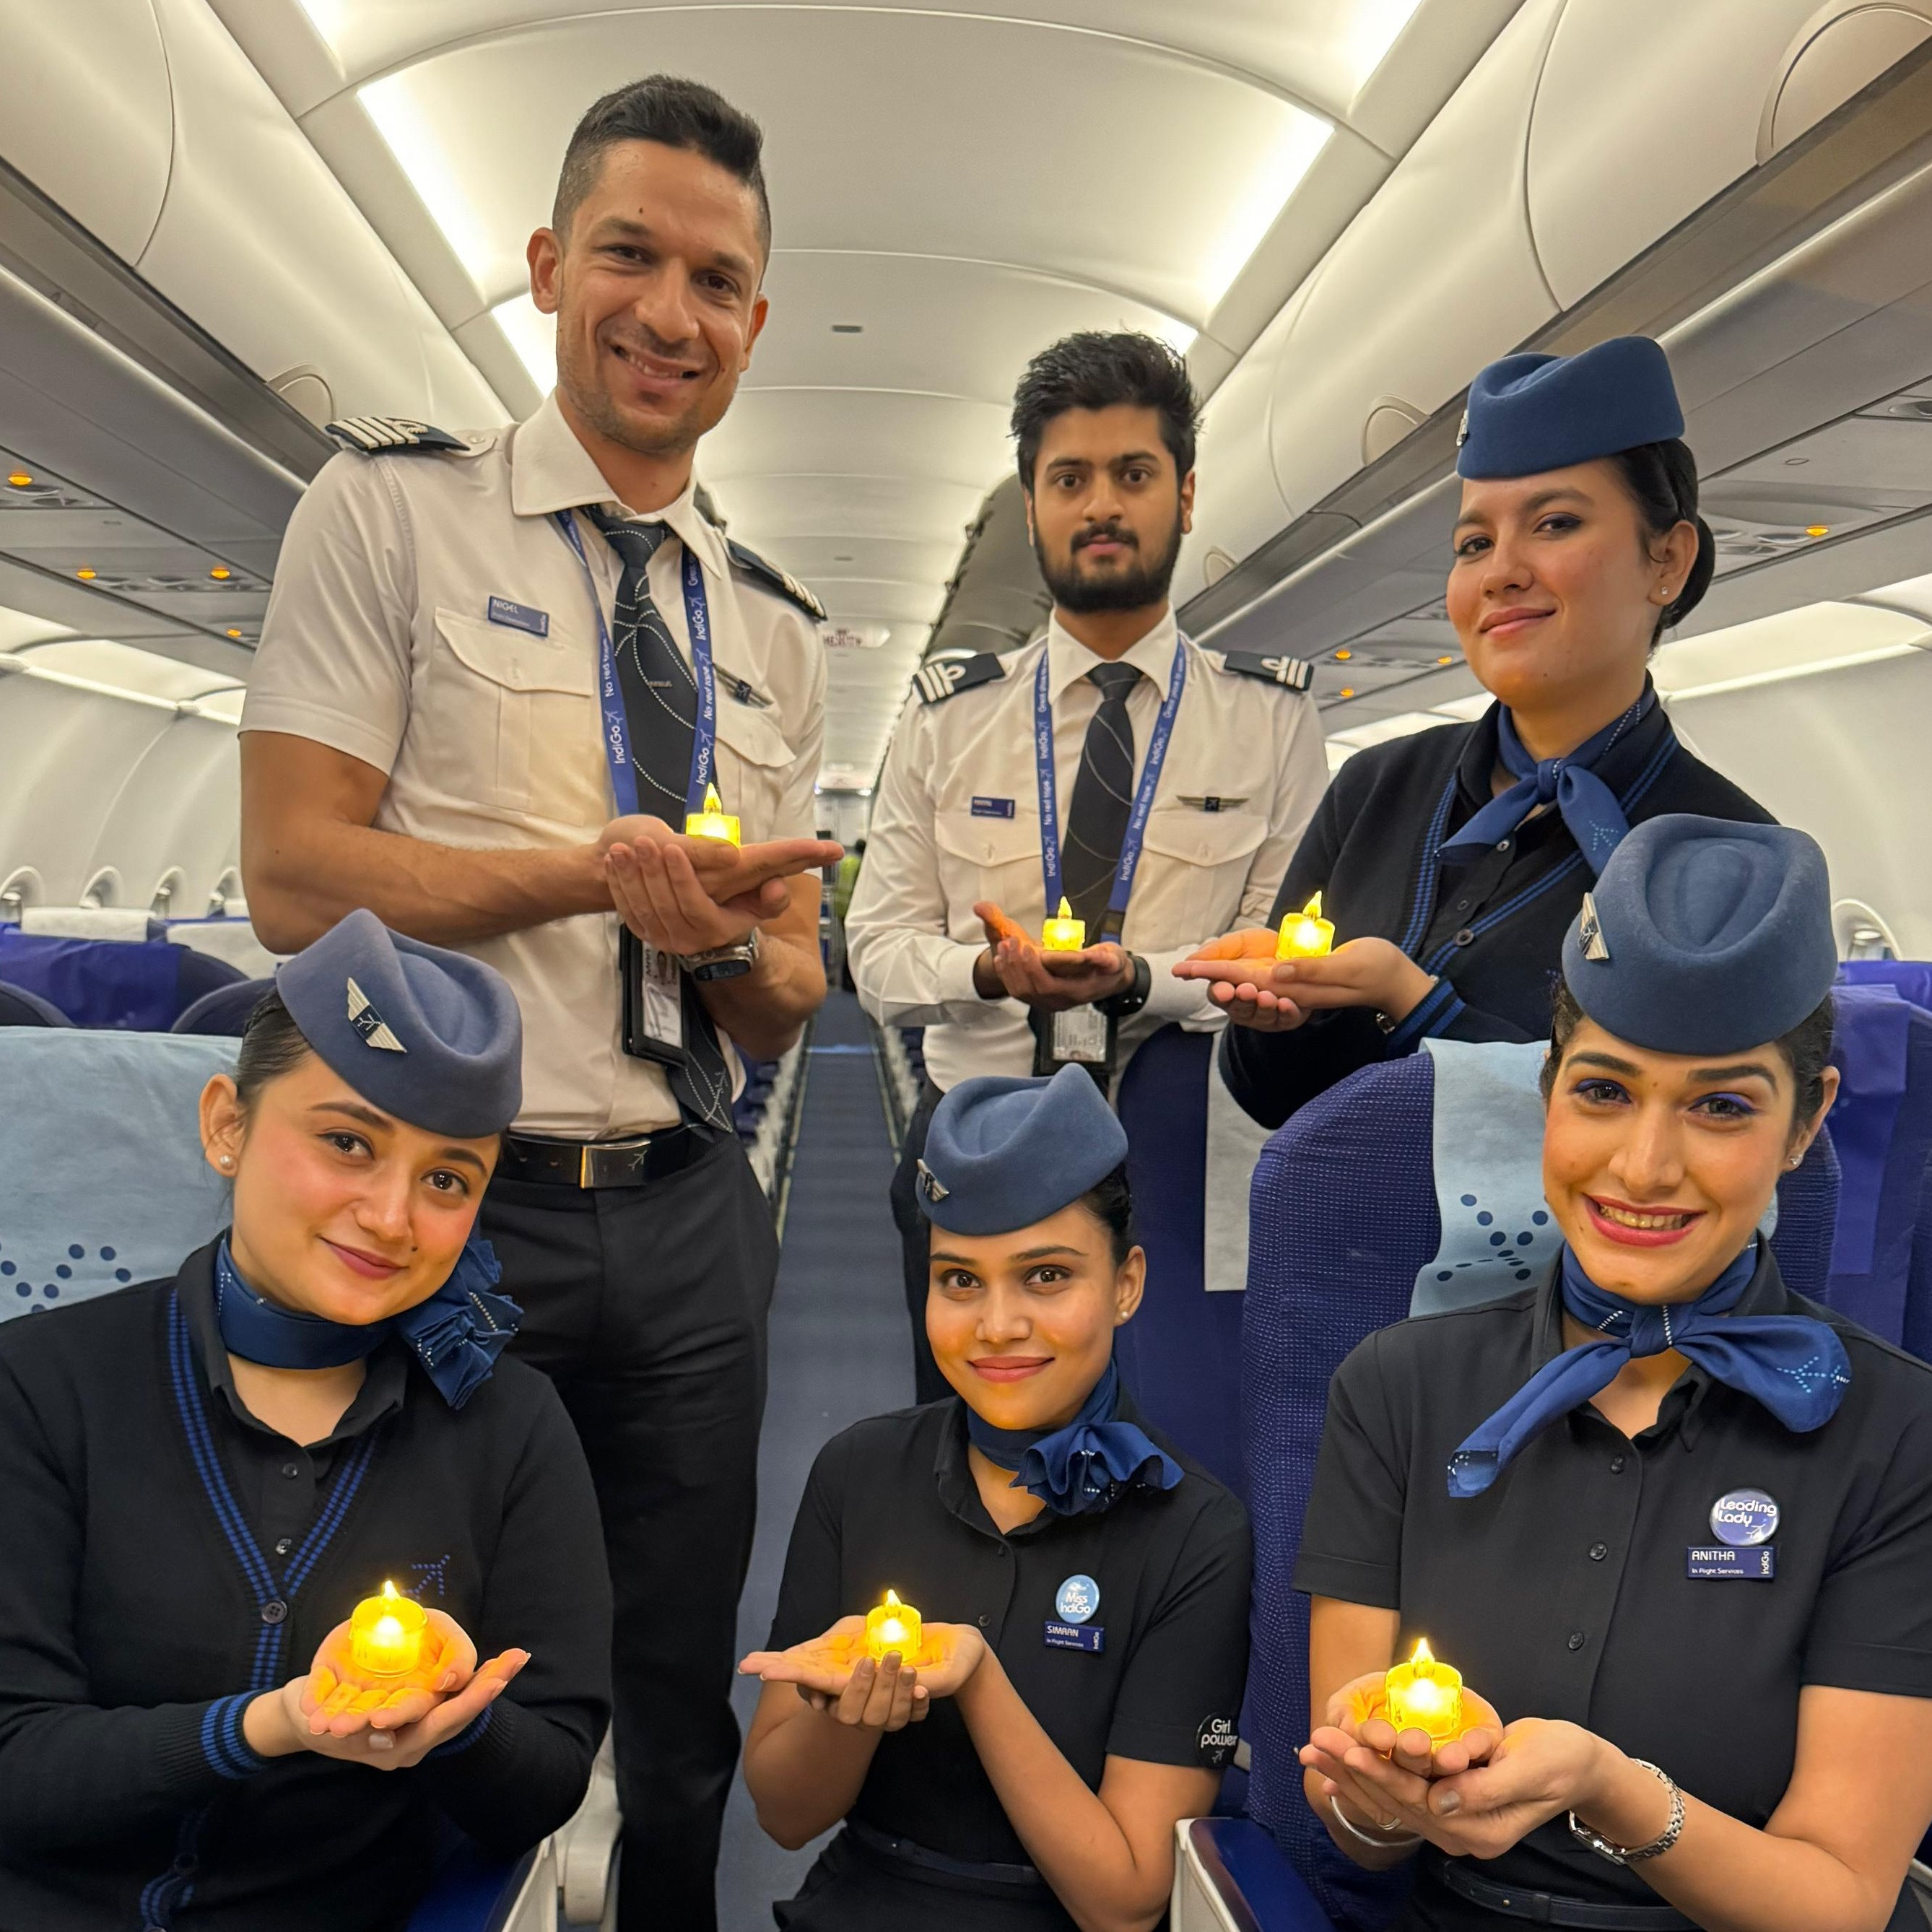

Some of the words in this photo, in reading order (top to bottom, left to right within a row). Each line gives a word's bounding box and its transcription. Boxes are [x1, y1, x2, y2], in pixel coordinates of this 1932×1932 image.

[692, 610, 707, 640] IndiGo
[702, 666, 713, 686] tape
[605, 682, 614, 697] No
[704, 686, 713, 705] red
[703, 706, 713, 721] No
[610, 725, 625, 764] IndiGo
[695, 747, 710, 785] IndiGo
[1045, 847, 1056, 877] IndiGo
[1120, 852, 1134, 881] IndiGo
[1720, 1498, 1776, 1517] Leading
[1718, 1510, 1752, 1527] Lady
[1692, 1551, 1735, 1561] ANITHA
[1761, 1551, 1770, 1575] IndiGo
[1066, 1592, 1088, 1603] Miss
[1060, 1602, 1091, 1614] IndiGo
[1211, 1718, 1230, 1733] Girl
[1201, 1733, 1238, 1749] power
